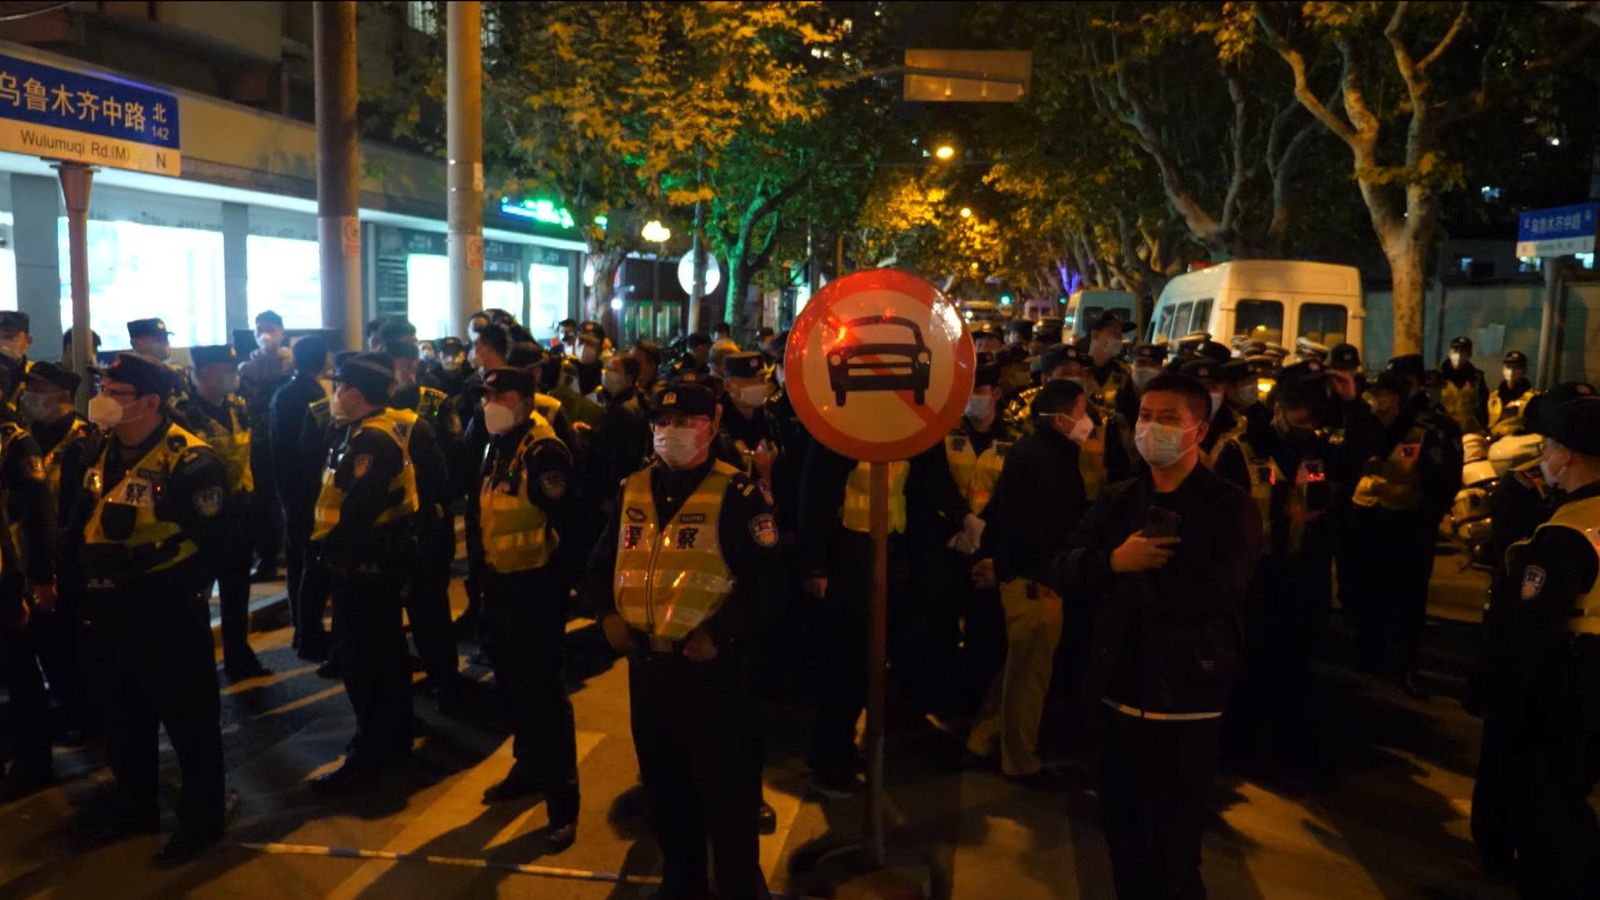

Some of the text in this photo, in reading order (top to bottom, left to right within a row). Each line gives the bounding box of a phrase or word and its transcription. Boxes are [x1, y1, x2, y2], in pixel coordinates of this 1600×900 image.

[0, 71, 146, 132] 乌鲁木齐中路
[153, 103, 167, 123] 北
[20, 129, 86, 158] Wulumuqi
[152, 126, 169, 141] 142
[156, 153, 166, 169] N
[677, 527, 699, 550] 察
